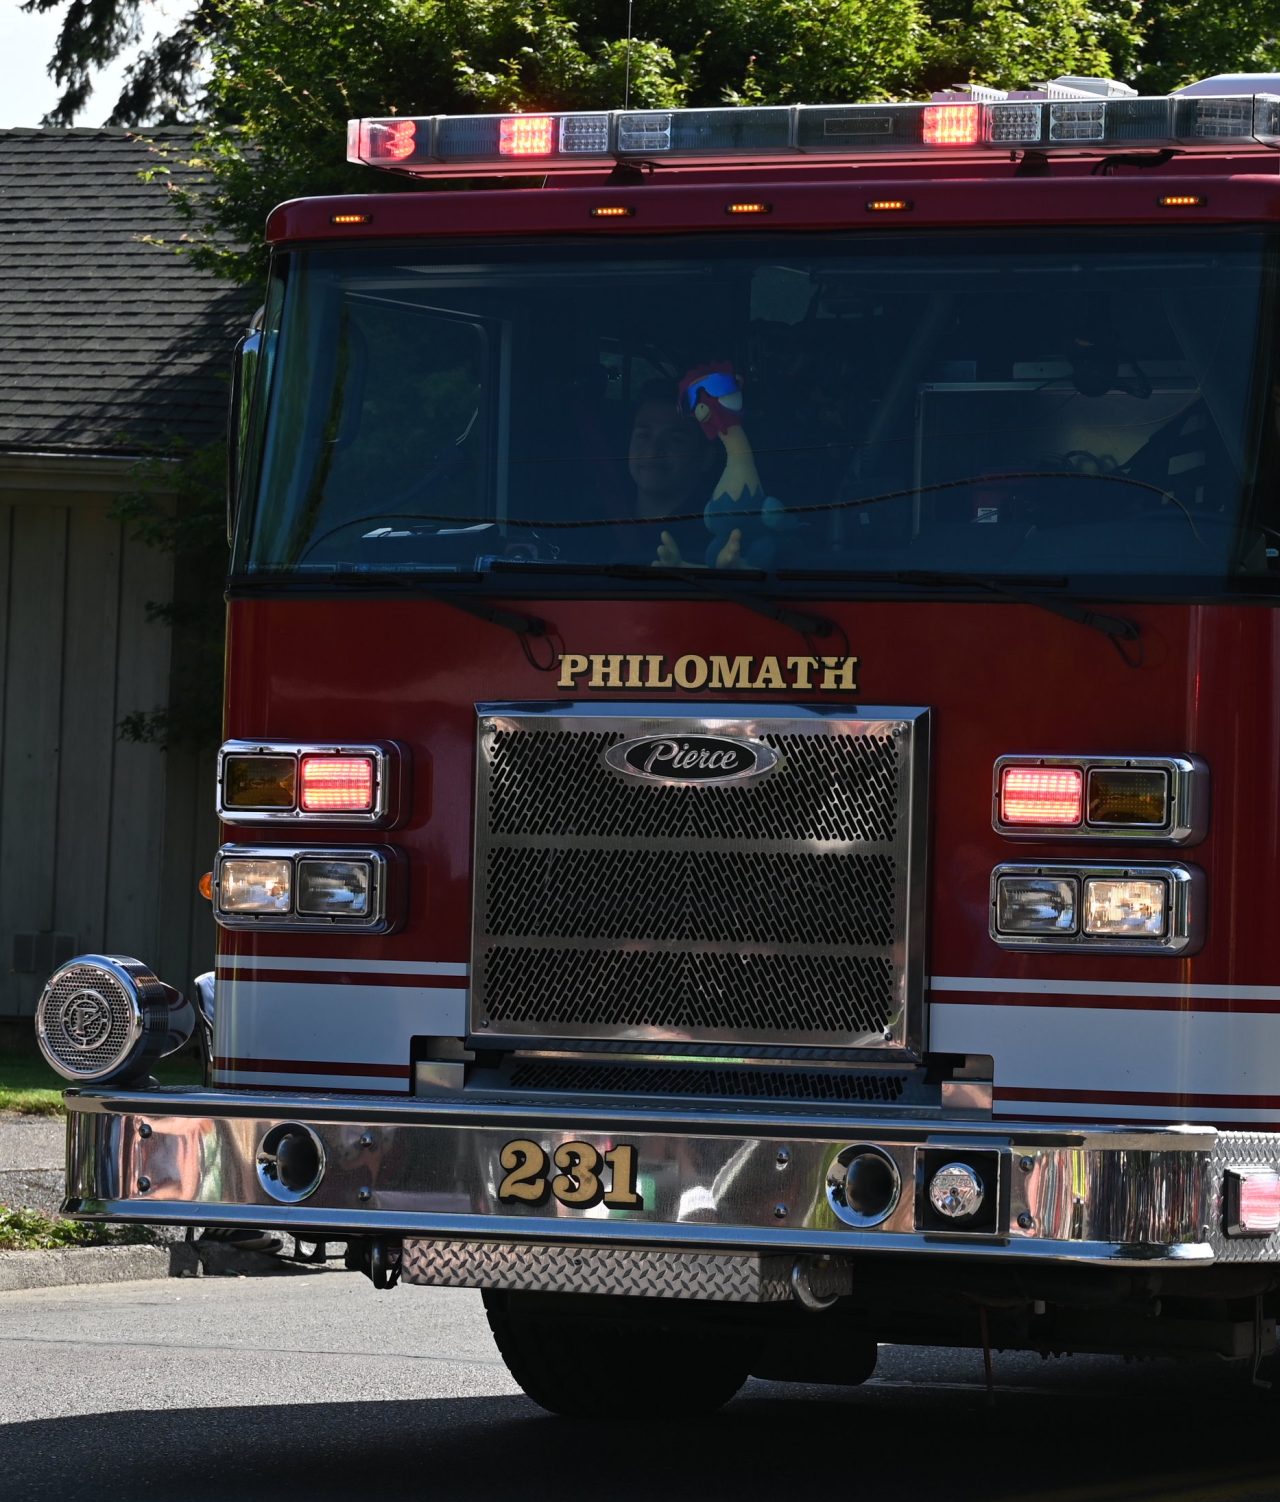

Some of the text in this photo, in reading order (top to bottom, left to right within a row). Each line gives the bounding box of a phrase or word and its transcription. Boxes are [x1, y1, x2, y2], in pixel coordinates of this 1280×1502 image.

[557, 653, 859, 691] PHILOMATH
[644, 740, 739, 773] Pierce
[497, 1138, 644, 1211] 231
